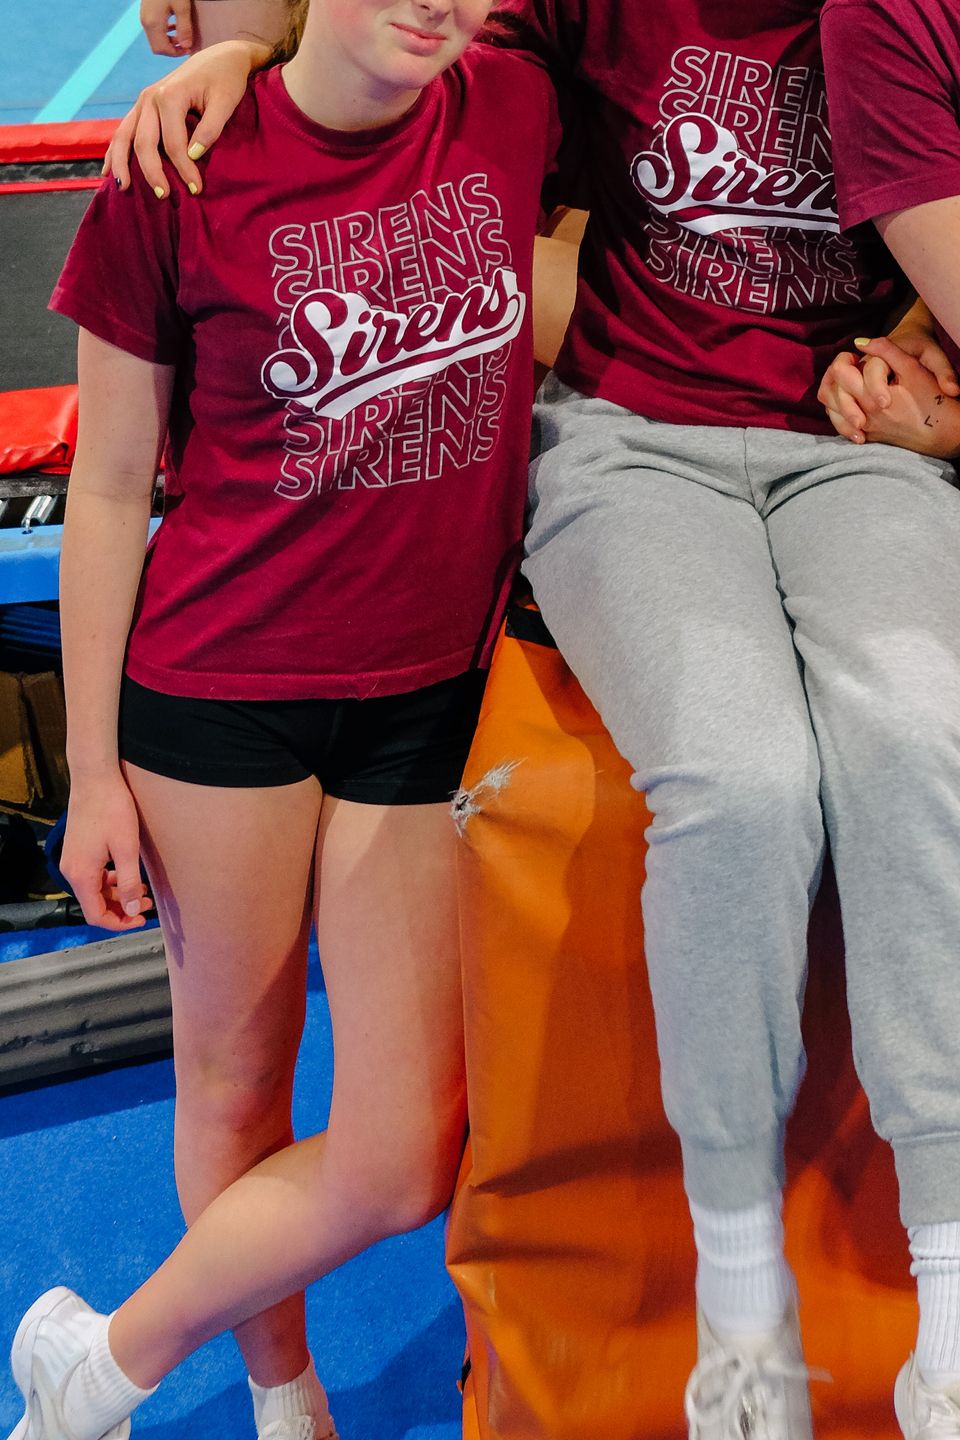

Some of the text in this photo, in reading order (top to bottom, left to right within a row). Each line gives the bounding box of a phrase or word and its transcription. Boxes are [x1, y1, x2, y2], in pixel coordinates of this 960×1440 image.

[663, 45, 830, 108] SIREN
[658, 88, 834, 160] SIREN
[629, 111, 842, 236] Siren
[268, 172, 502, 279] SIRENS
[273, 218, 512, 312] SIRENS
[645, 238, 862, 315] SIRENS
[260, 266, 526, 421] Sirens
[282, 370, 508, 457] SIRENS
[273, 414, 501, 501] SIRENS
